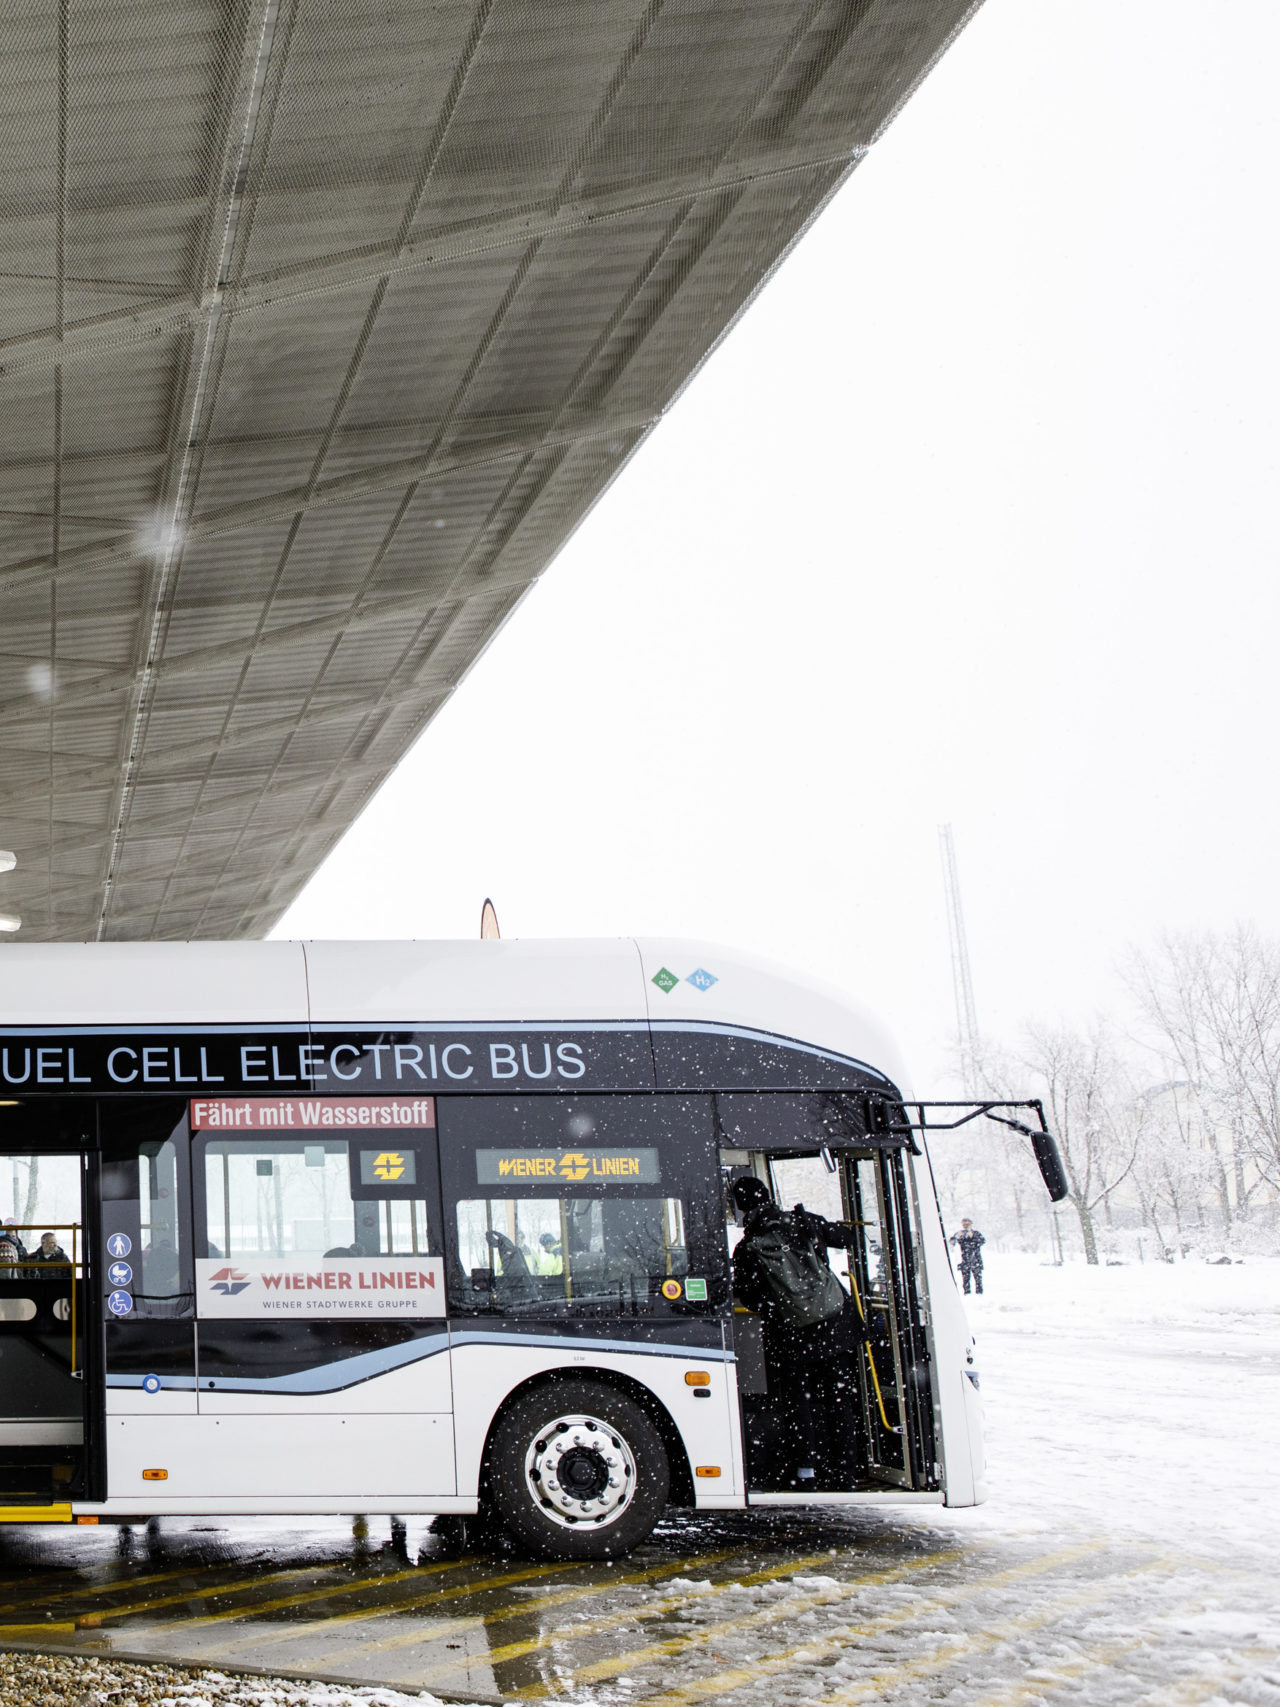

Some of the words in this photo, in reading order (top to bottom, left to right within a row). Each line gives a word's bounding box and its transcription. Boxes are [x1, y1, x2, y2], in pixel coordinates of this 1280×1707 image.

[106, 1046, 225, 1083] CELL
[239, 1043, 475, 1082] ELECTRIC
[488, 1042, 587, 1080] BUS
[193, 1101, 254, 1127] Fährt
[258, 1101, 295, 1126] mit
[298, 1100, 429, 1125] Wasserstoff
[498, 1157, 558, 1176] WIENER
[592, 1157, 641, 1175] LINIEN
[260, 1272, 354, 1291] WIENER
[358, 1271, 436, 1290] LINIEN
[262, 1300, 303, 1310] WIENER
[306, 1300, 374, 1309] STADTWERKE
[377, 1300, 418, 1309] GRUPPE
